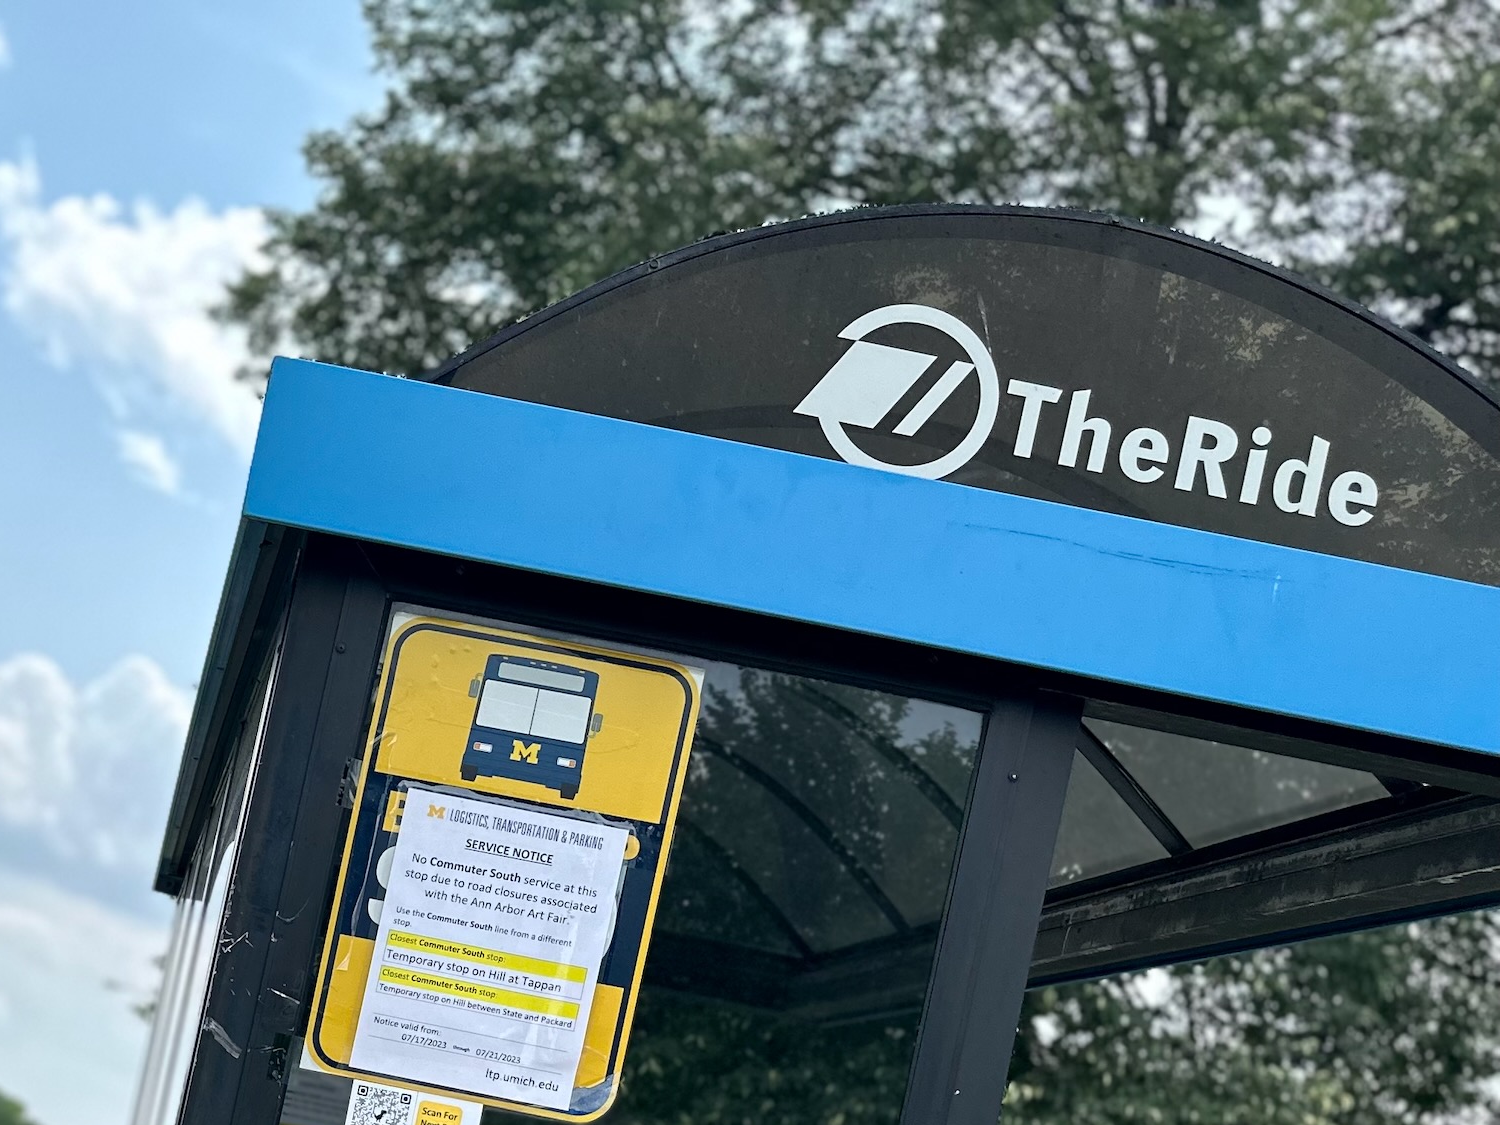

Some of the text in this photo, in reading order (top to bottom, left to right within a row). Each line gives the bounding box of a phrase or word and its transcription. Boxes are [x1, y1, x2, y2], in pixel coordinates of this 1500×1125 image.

[1007, 378, 1378, 526] TheRide
[510, 739, 542, 765] M
[449, 808, 489, 829] LOGISTICS,
[492, 816, 560, 842] TRANSPORTATION
[560, 830, 567, 843] &
[568, 831, 604, 850] PARKING
[465, 838, 553, 863] SERVICE NOTICE
[411, 852, 597, 897] No Commuter South service at this
[404, 869, 597, 913] stop due to road closures associated
[393, 918, 412, 927] stop.
[424, 889, 569, 925] with the Ann Arbor Art Fair.
[396, 906, 410, 915] Use
[412, 909, 425, 918] the
[426, 912, 468, 926] Commuter
[469, 920, 493, 931] South
[494, 925, 509, 935] line
[510, 928, 529, 938] from
[537, 934, 572, 946] different
[389, 933, 417, 945] Closest
[419, 939, 460, 953] Commuter
[461, 947, 484, 958] South
[381, 968, 409, 980] Closest
[411, 974, 453, 988] Commuter
[454, 983, 477, 994] South
[386, 948, 561, 992] Temporary stop on Hill at Tappan
[379, 982, 421, 999] Temporary
[422, 993, 439, 1003] stop
[452, 998, 465, 1007] Hill
[467, 1001, 500, 1014] between
[502, 1008, 522, 1018] State
[540, 1015, 572, 1028] Packard
[373, 1016, 399, 1027] Notice
[400, 1023, 419, 1031] valid
[401, 1033, 447, 1049] 07/17/2023
[475, 1048, 520, 1064] 07/21/2023
[485, 1068, 558, 1091] ltp.umich.edu
[421, 1107, 458, 1121] Scan For
